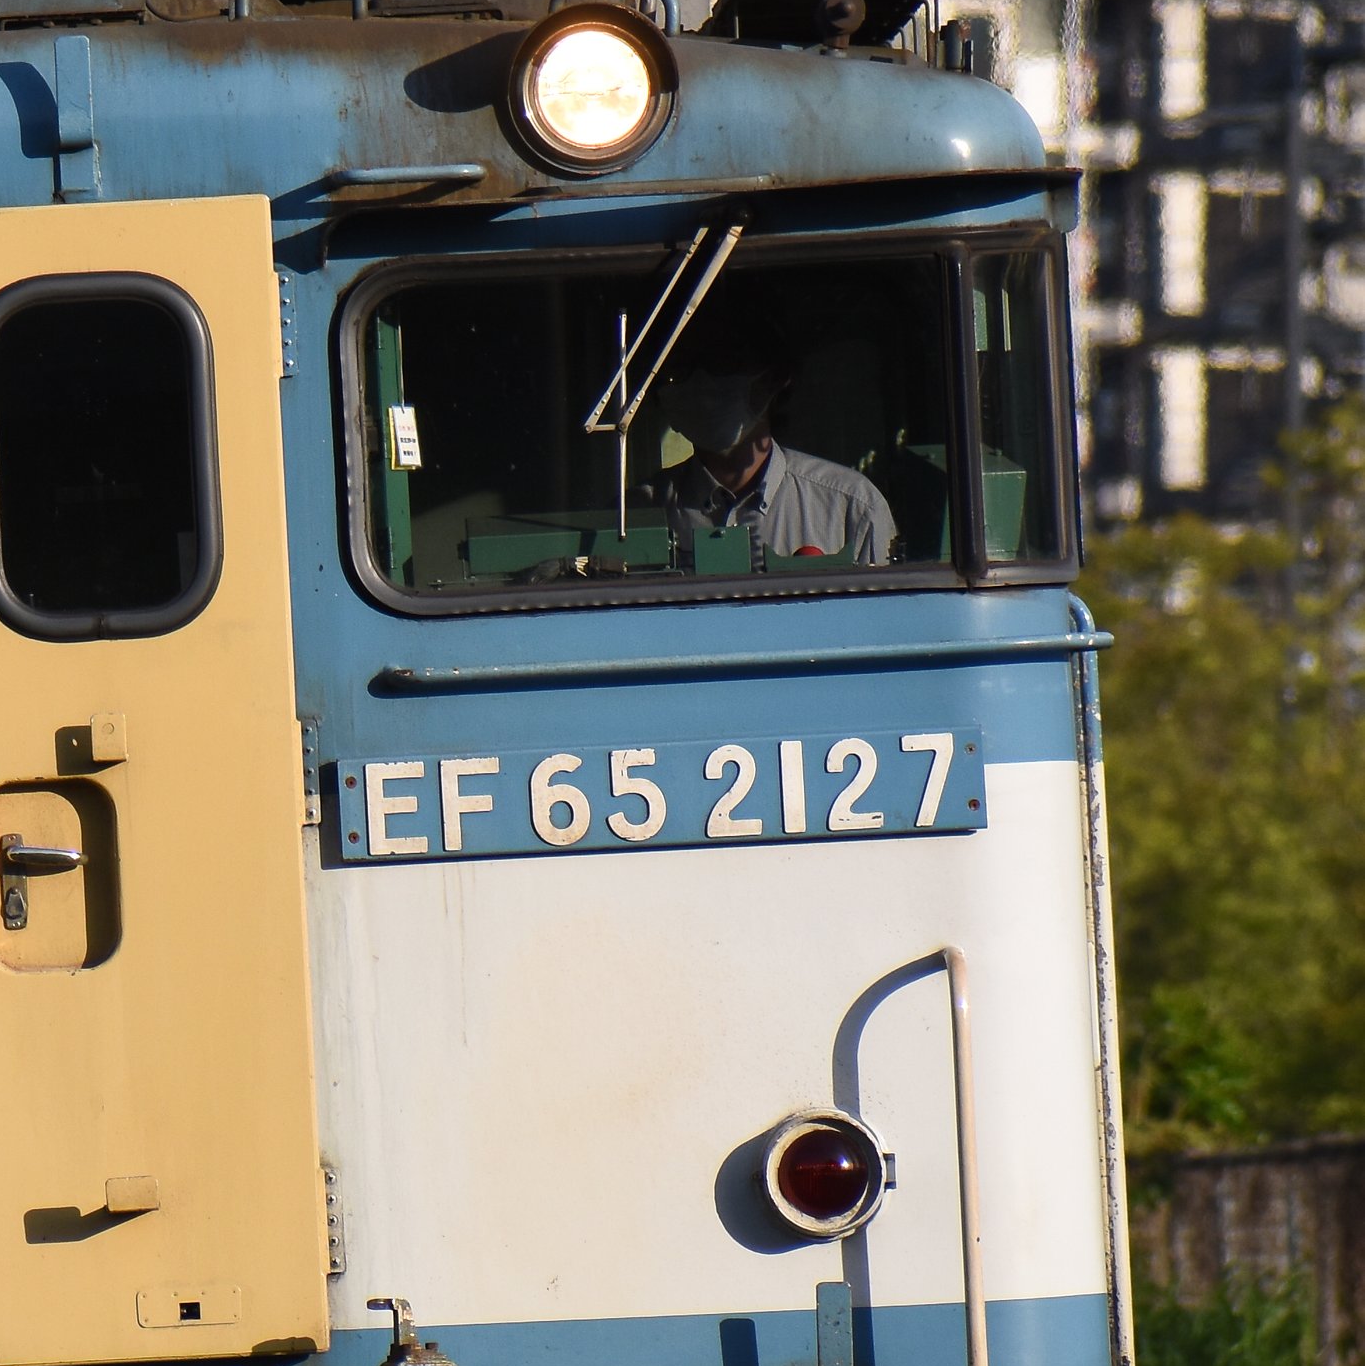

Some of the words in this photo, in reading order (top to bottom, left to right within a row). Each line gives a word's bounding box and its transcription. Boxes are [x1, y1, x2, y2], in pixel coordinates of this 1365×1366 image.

[364, 757, 501, 856] EF
[529, 748, 666, 846] 65
[704, 732, 954, 839] 2127
